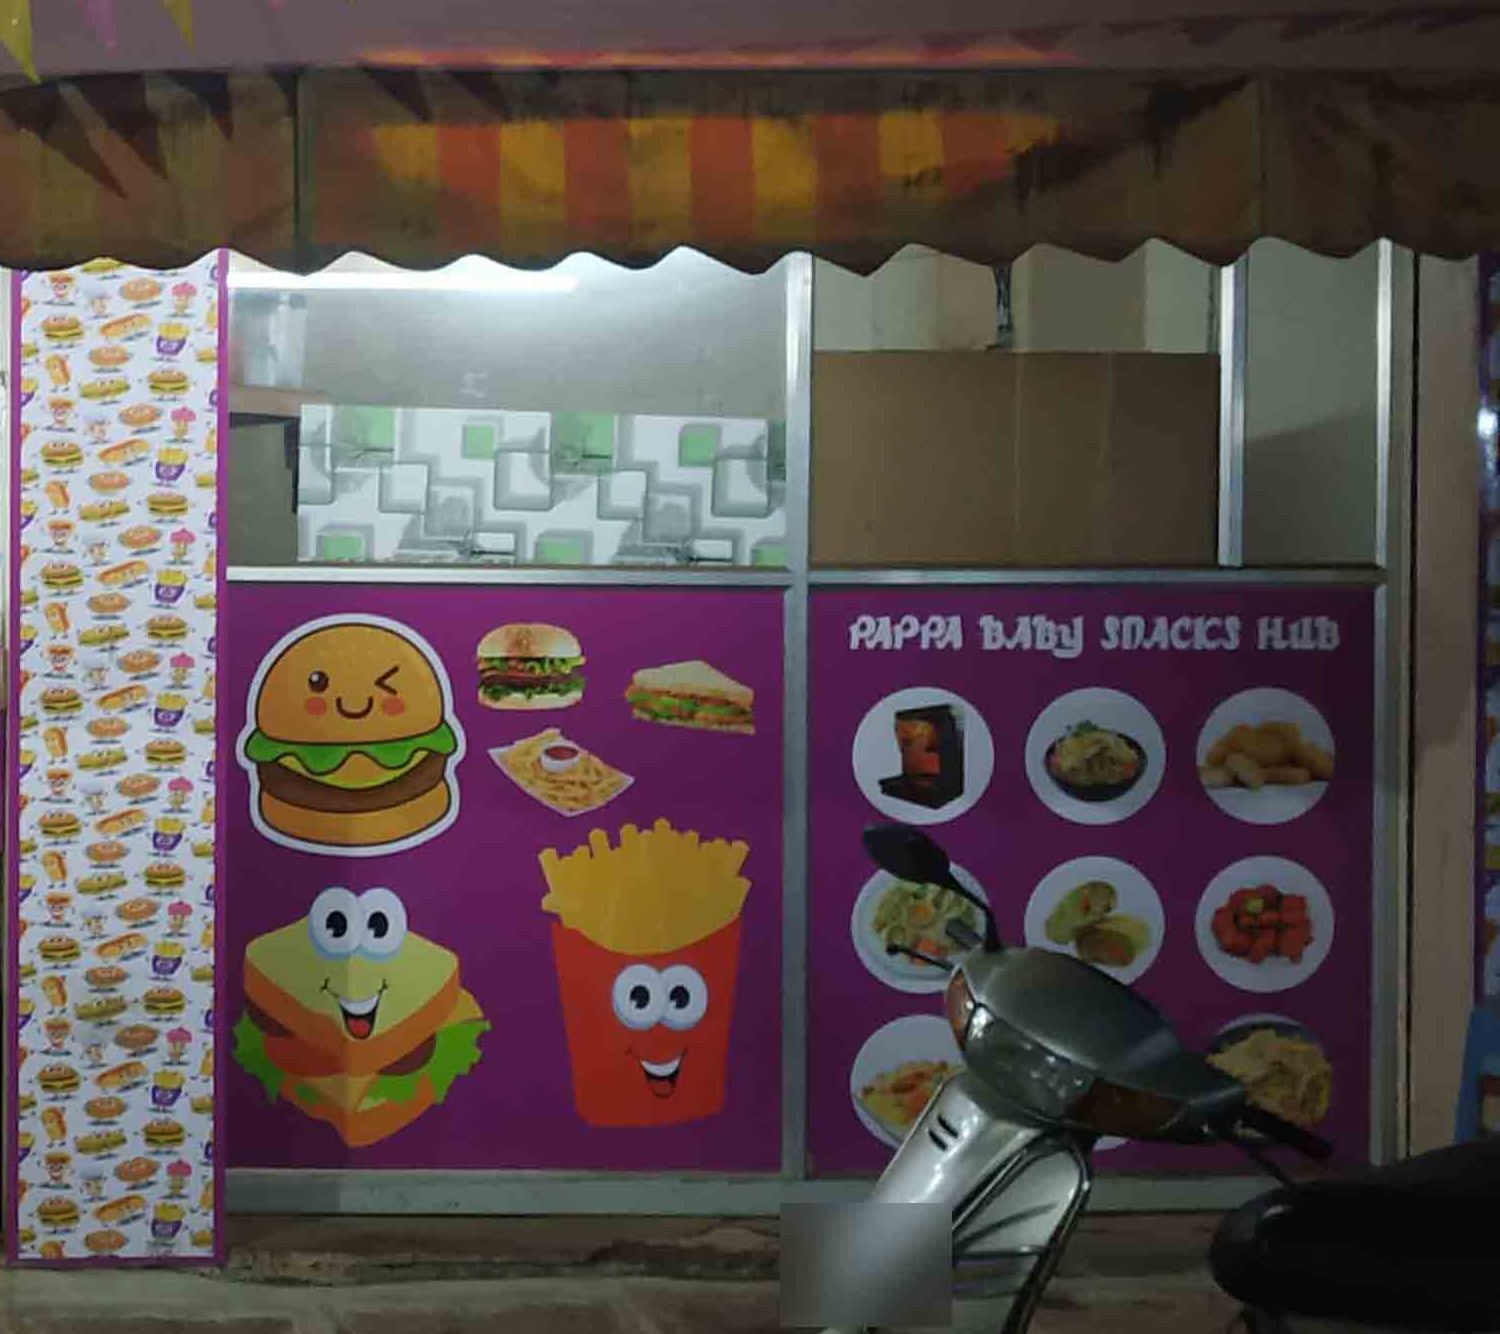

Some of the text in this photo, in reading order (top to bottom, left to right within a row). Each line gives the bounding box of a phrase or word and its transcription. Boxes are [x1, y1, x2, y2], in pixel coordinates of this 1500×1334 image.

[848, 614, 965, 651] PAPPA
[1100, 614, 1242, 652] SNACKS
[1256, 615, 1341, 652] HUB
